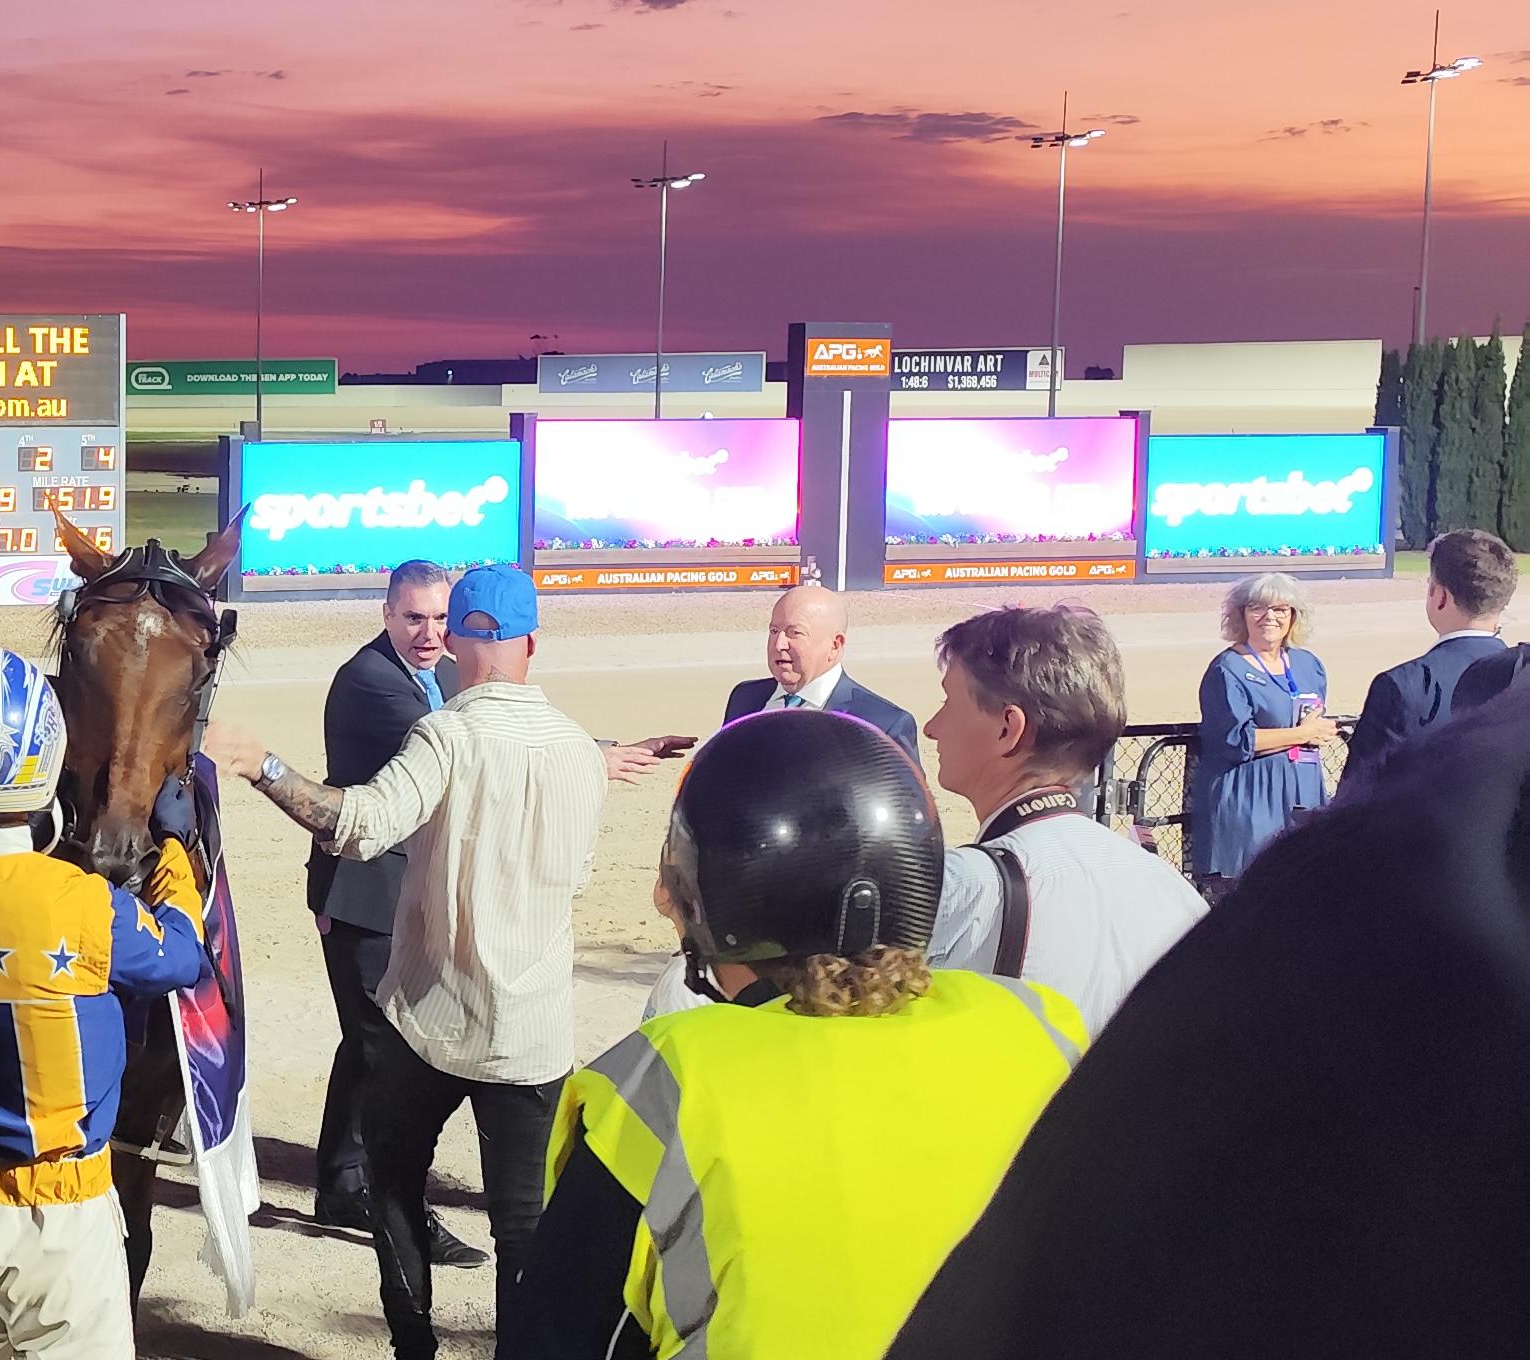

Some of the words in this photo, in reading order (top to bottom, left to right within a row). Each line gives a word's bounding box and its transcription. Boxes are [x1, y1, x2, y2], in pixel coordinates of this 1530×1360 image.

[28, 326, 89, 354] THE
[813, 343, 857, 360] APG
[893, 355, 973, 374] LOCHINVAR
[978, 354, 1004, 372] ART
[14, 360, 58, 387] AT
[186, 374, 238, 382] DOWNLOAD
[240, 374, 257, 382] THE
[278, 374, 296, 382] APP
[298, 373, 329, 382] TODAY
[18, 435, 33, 447] 4TH
[81, 434, 96, 446] 5TH
[34, 447, 52, 471] 2
[98, 447, 115, 469] 4
[32, 476, 58, 487] MILE
[61, 476, 89, 487] RATE
[43, 487, 115, 510] 1:51.9
[1151, 470, 1358, 528] sportsbet
[249, 478, 490, 542] sportsbet
[750, 570, 775, 581] APG
[893, 569, 917, 579] APG
[945, 567, 1009, 579] AUSTRALIAN
[1010, 566, 1047, 577] PACING
[1049, 565, 1077, 576] GOLD
[1088, 565, 1112, 575] APG
[541, 573, 568, 585] APG
[597, 572, 665, 585] AUSTRALIAN
[667, 571, 707, 583] PACING
[708, 571, 737, 582] GOLD
[1015, 793, 1077, 817] Canon
